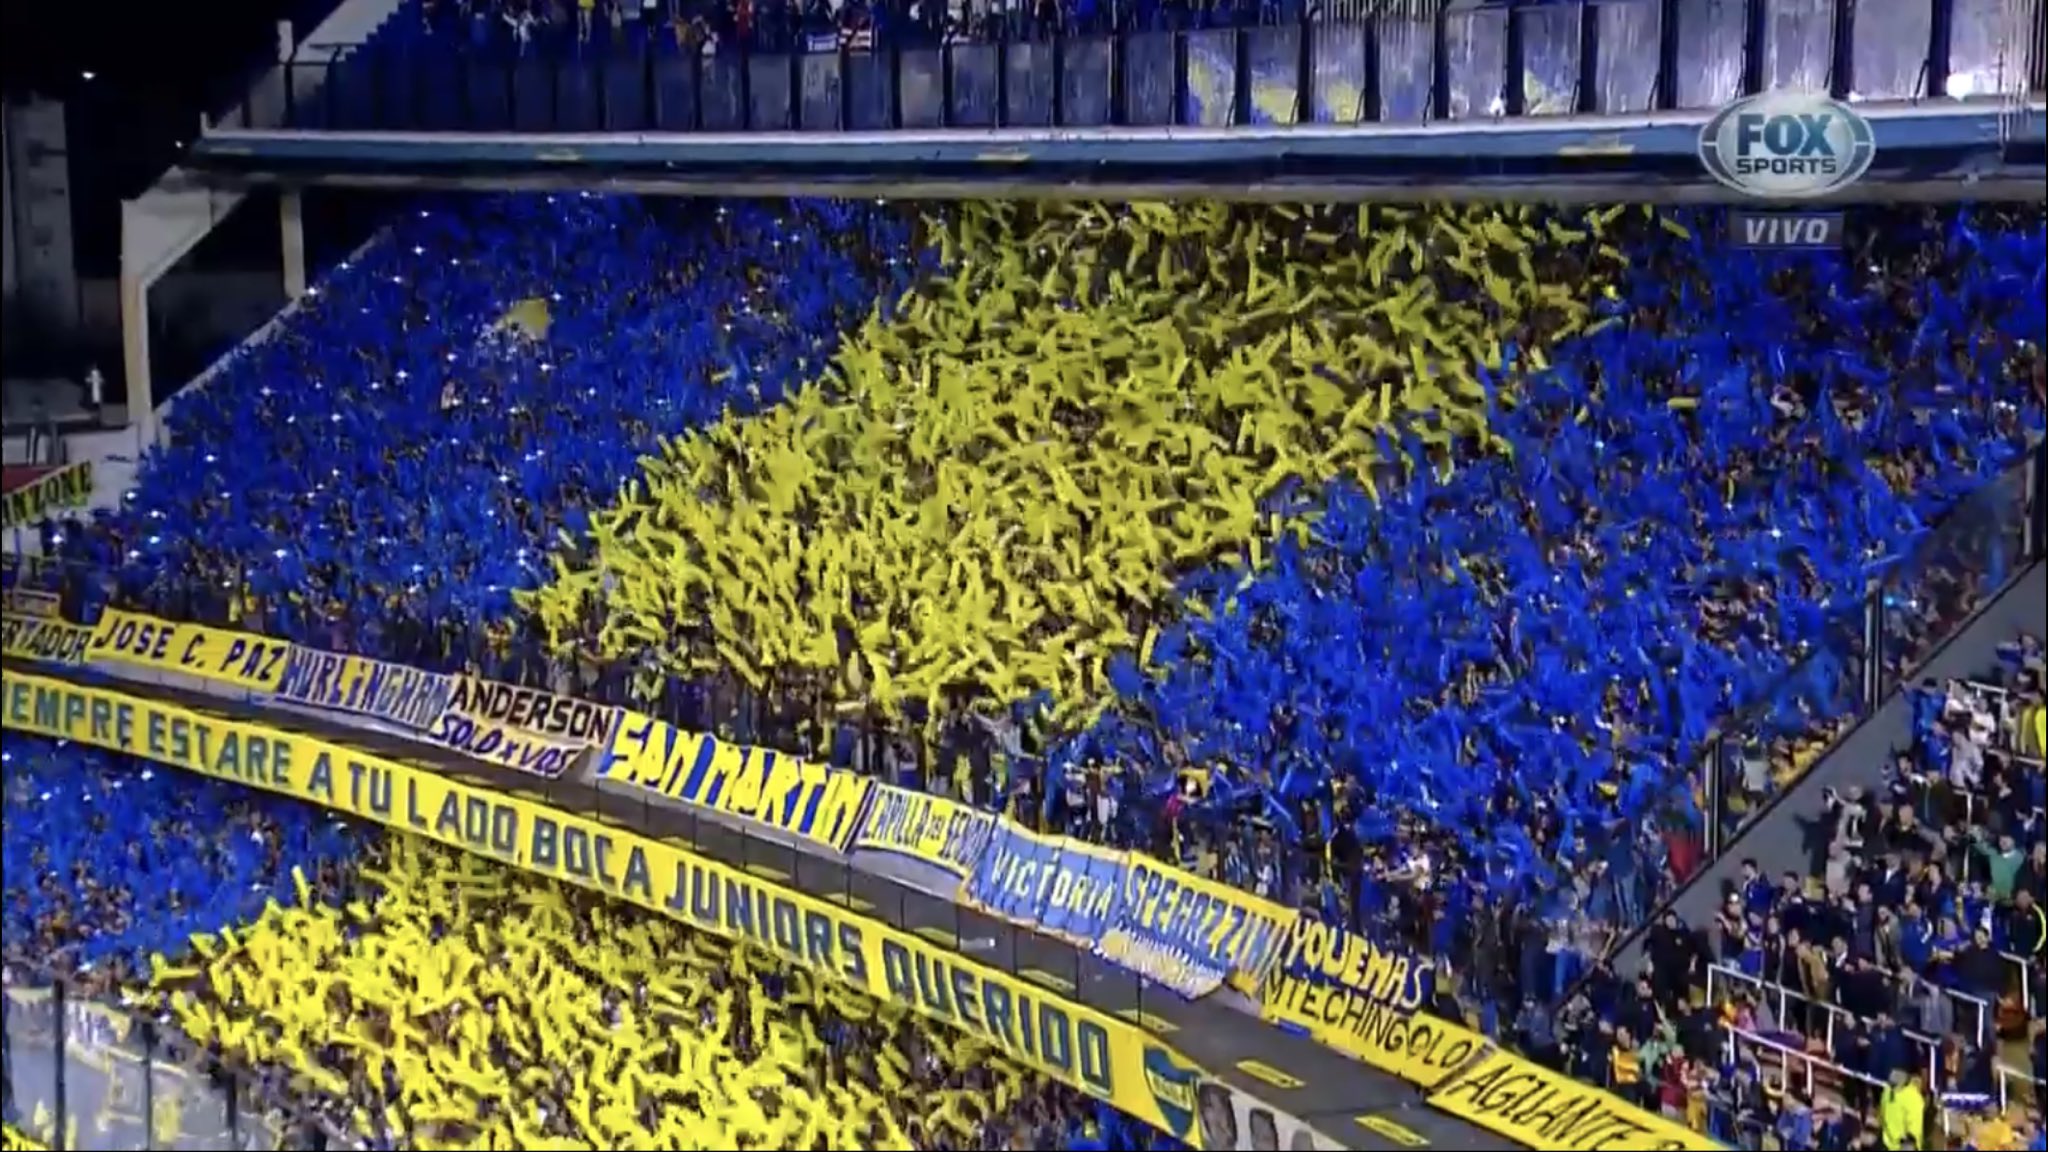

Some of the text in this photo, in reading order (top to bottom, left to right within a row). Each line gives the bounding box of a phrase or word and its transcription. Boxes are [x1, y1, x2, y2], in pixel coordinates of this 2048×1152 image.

[94, 617, 175, 660] JOSE
[220, 638, 278, 681] PAZ
[448, 672, 613, 743] ANDERSON
[606, 707, 870, 853] SAN MARTIN
[148, 710, 291, 785] ESTARE
[308, 752, 334, 802] A
[348, 761, 392, 815] TU
[532, 815, 654, 900] BOCA
[666, 860, 868, 990] JUNIORS
[882, 938, 1114, 1096] QUERIDO
[991, 847, 1118, 921] VICTORIA
